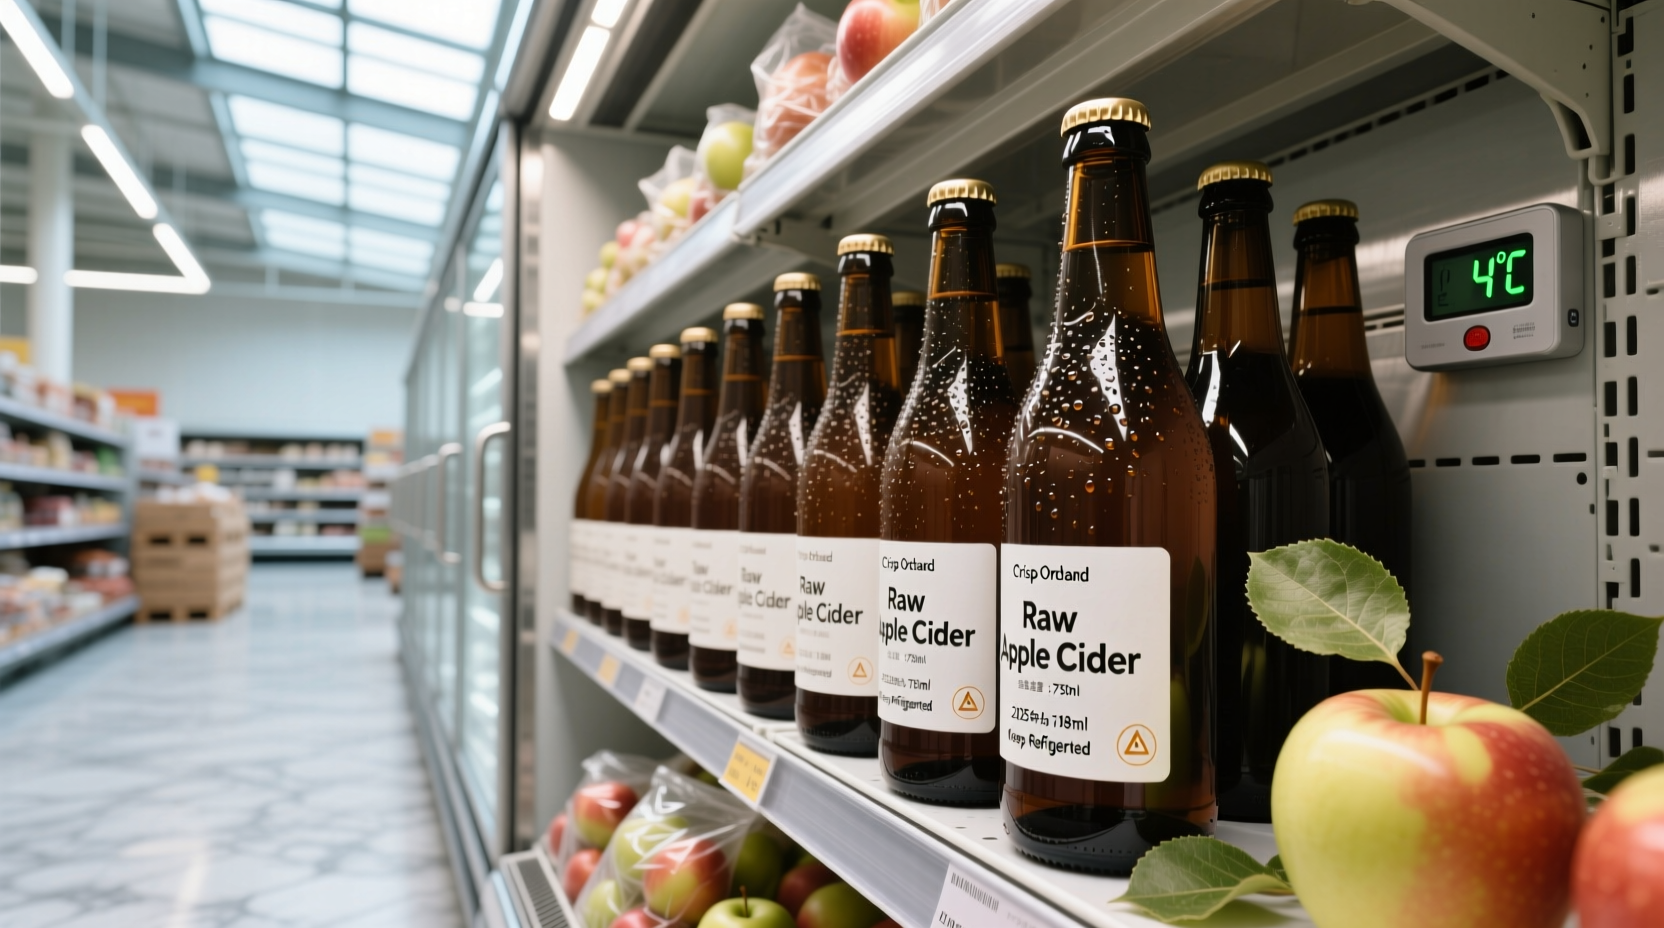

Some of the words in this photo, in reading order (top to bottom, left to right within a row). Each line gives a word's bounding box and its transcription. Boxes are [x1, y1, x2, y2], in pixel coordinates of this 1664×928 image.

[1472, 249, 1526, 298] 4°C
[800, 575, 826, 597] Raw
[1013, 563, 1038, 584] Crisp
[816, 602, 864, 625] Cider
[888, 586, 925, 613] Raw
[1023, 600, 1078, 633] Raw
[912, 619, 976, 648] Cider
[1001, 633, 1050, 673] Apple
[1057, 642, 1142, 675] Cider
